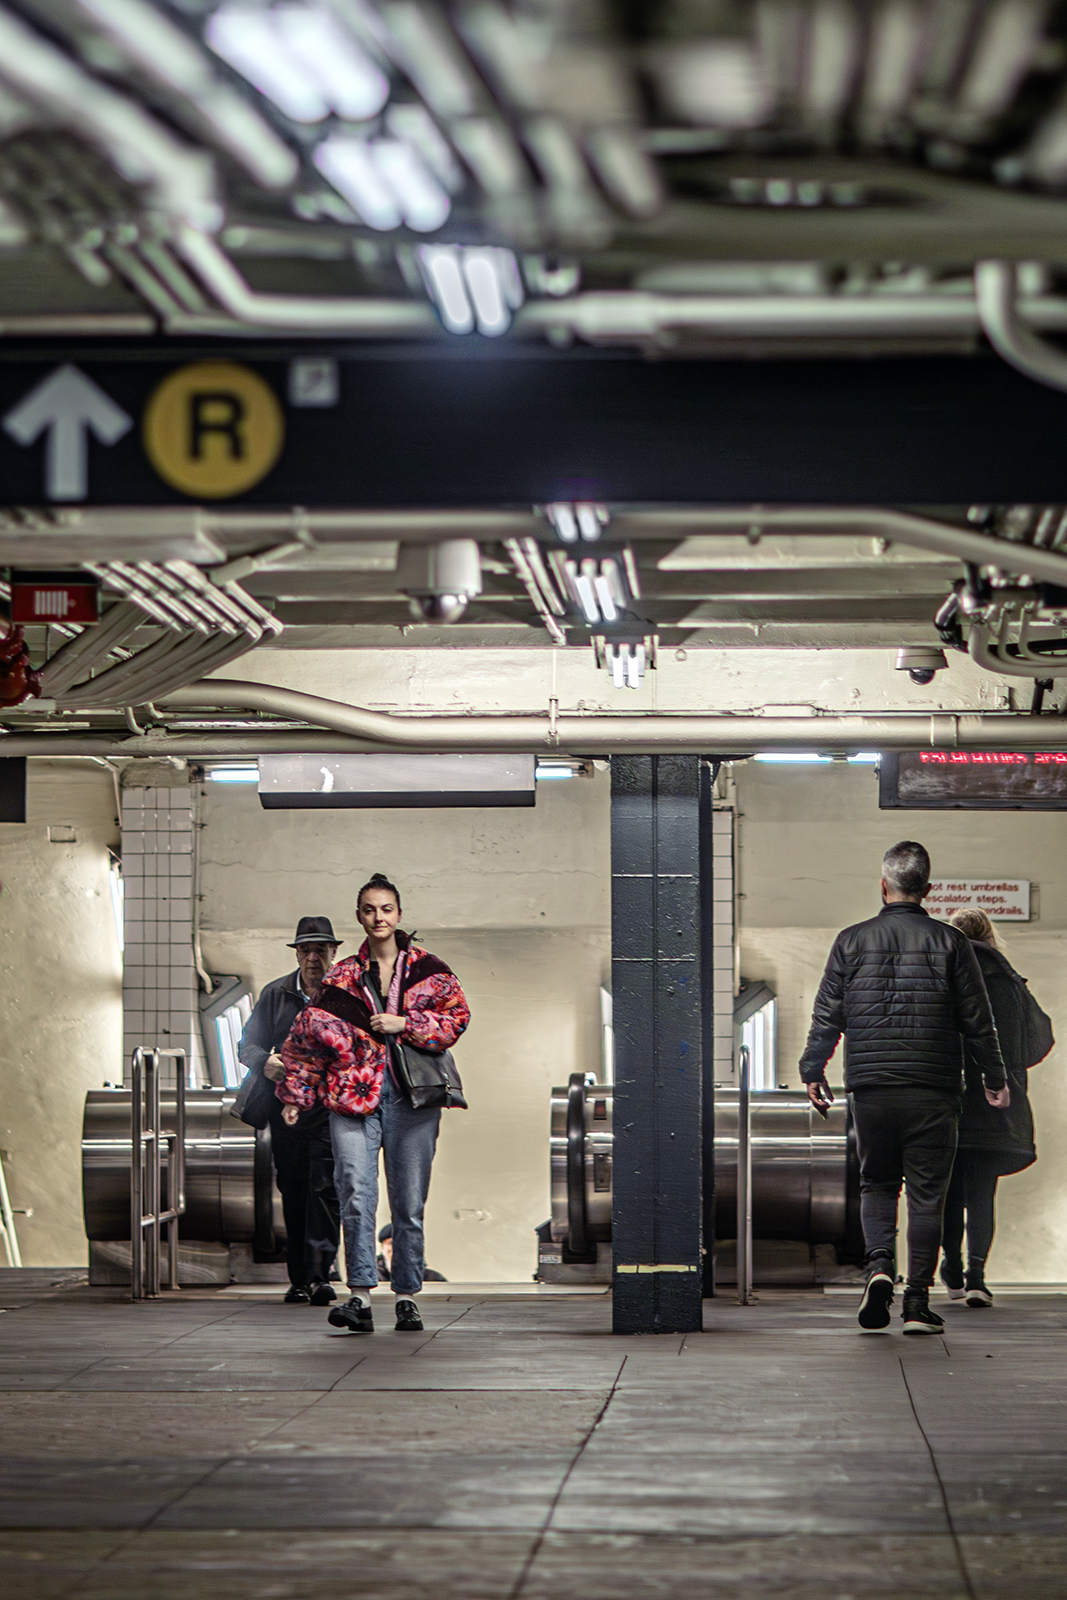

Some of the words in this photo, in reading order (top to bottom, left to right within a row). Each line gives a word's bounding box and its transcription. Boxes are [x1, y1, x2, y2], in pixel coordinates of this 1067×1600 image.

[187, 390, 245, 463] R
[946, 883, 967, 891] rest
[970, 882, 1019, 892] umbrellas
[925, 894, 972, 903] escalator
[976, 894, 1007, 904] steps.
[977, 905, 1025, 915] andrails.
